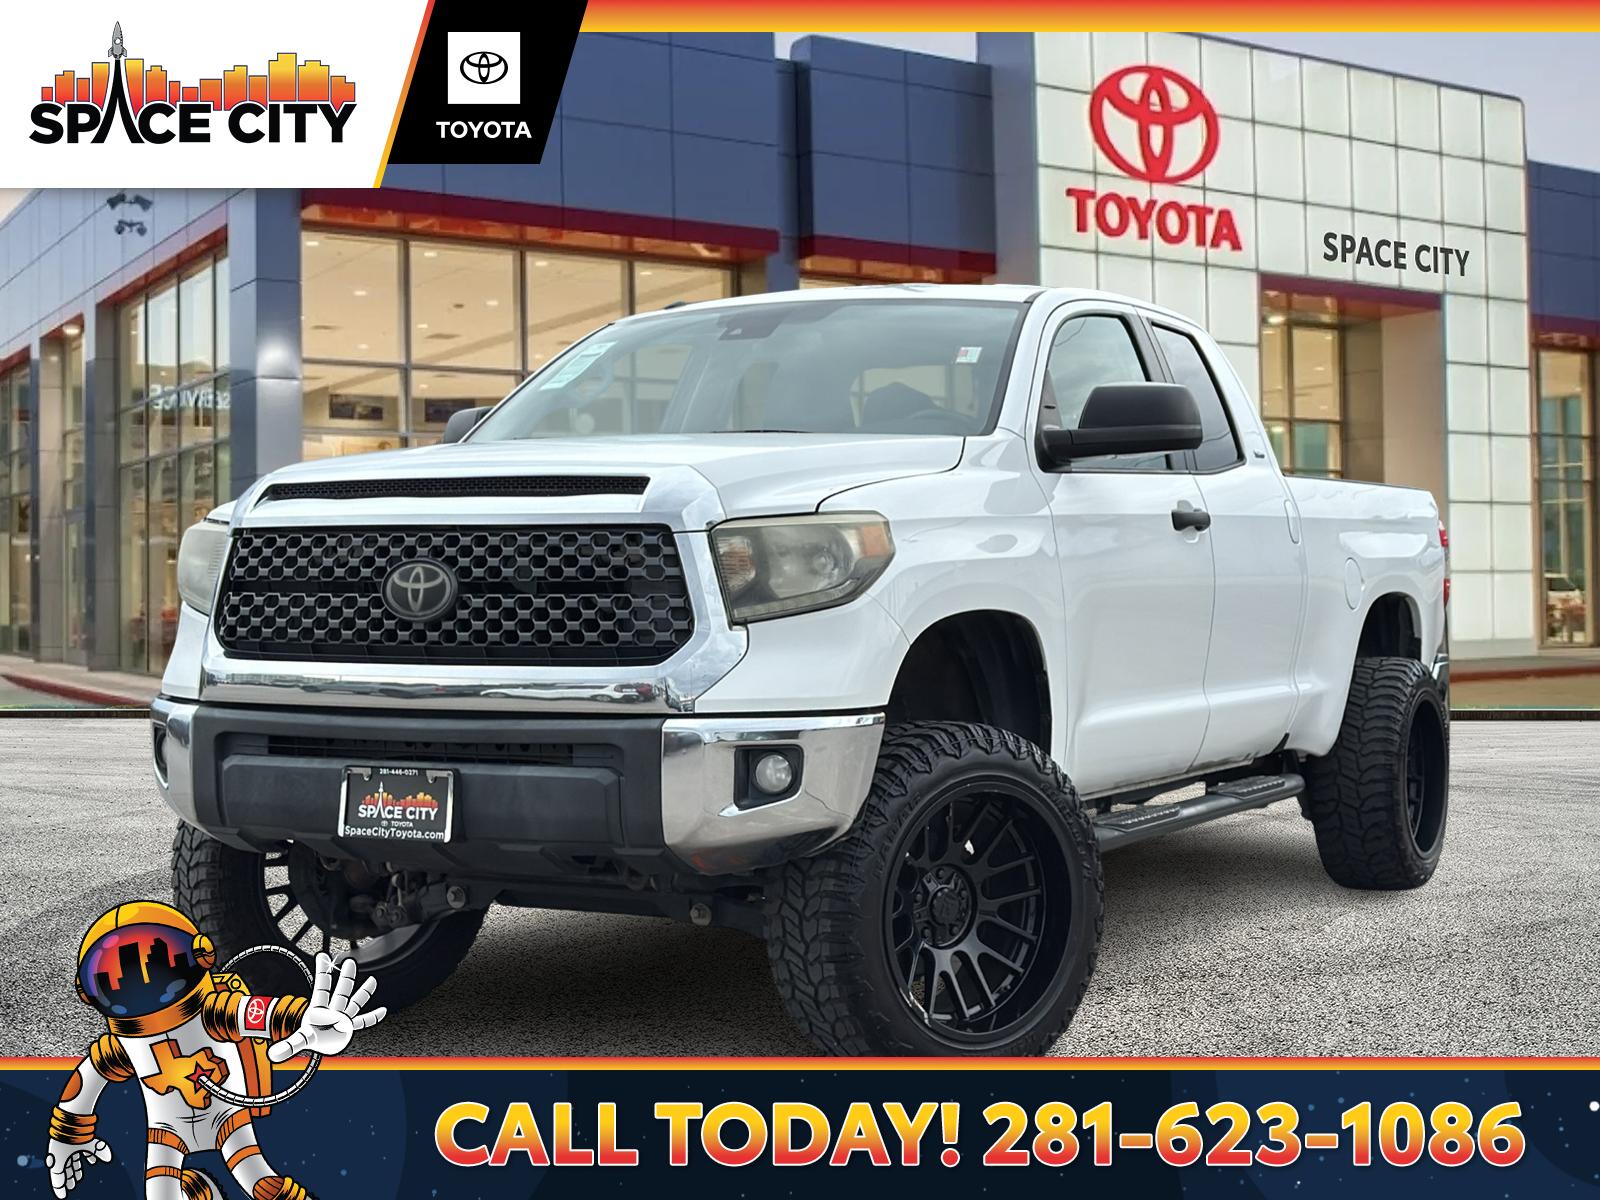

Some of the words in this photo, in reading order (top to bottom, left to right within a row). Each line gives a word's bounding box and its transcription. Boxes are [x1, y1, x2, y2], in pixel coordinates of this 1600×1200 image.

[1066, 187, 1243, 251] TOYOTA
[1323, 232, 1407, 270] SPACE
[1414, 244, 1470, 277] CITY
[406, 807, 438, 820] CITY
[345, 825, 444, 840] SpaceCityToyota.com
